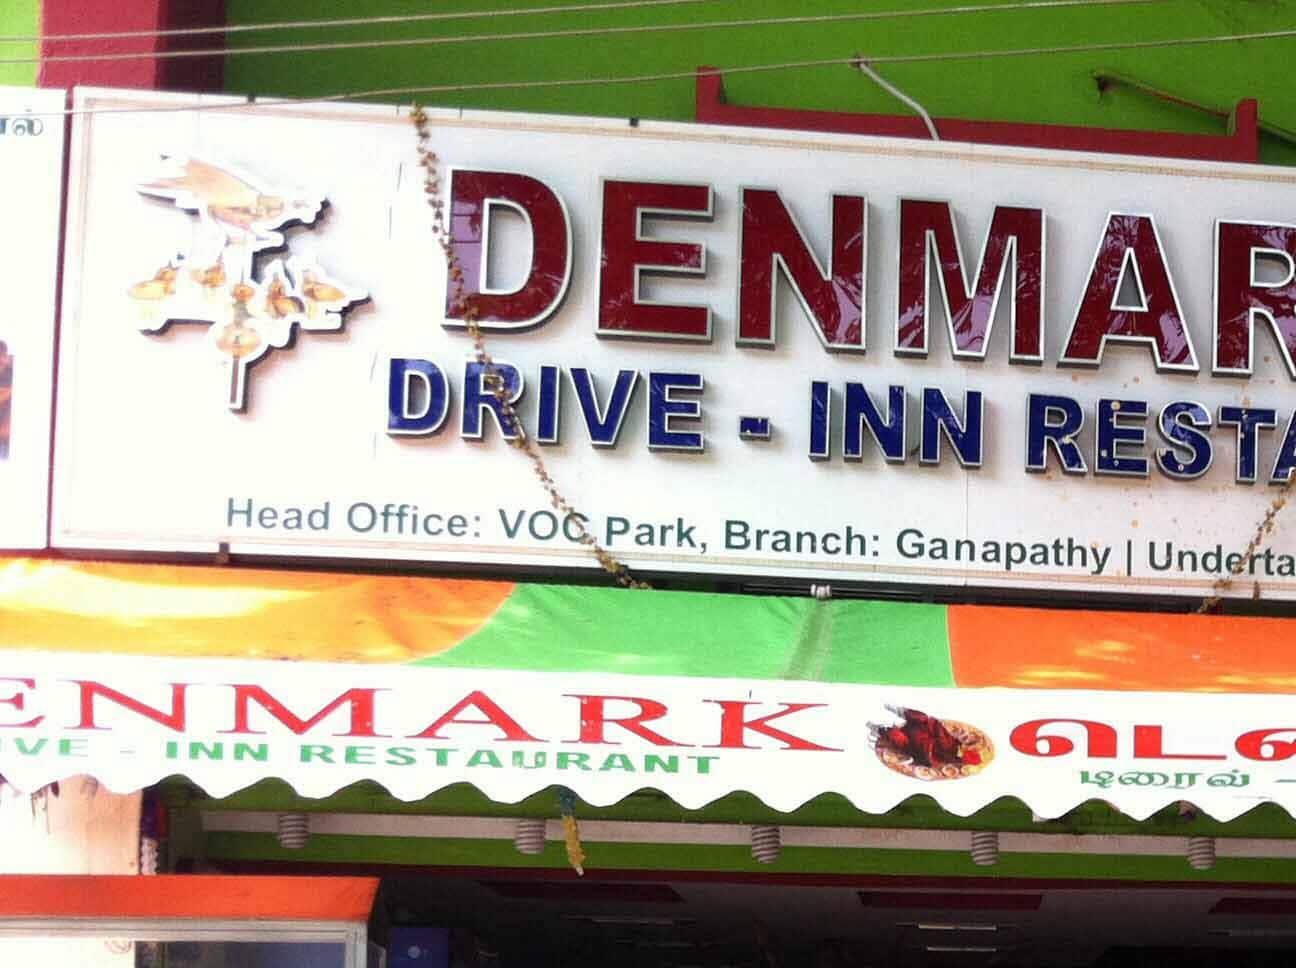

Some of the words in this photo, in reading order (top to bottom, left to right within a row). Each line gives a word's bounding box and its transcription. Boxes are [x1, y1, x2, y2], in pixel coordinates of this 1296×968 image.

[385, 357, 705, 454] DRIVE
[808, 380, 984, 470] INN
[226, 497, 331, 533] Head
[347, 501, 483, 540] Office:
[498, 508, 588, 545] VOC
[605, 513, 708, 555] Park,
[724, 518, 881, 558] Branch:
[896, 527, 1112, 577] Ganapathy
[165, 739, 270, 764] INN
[299, 742, 722, 775] RESTAURANT
